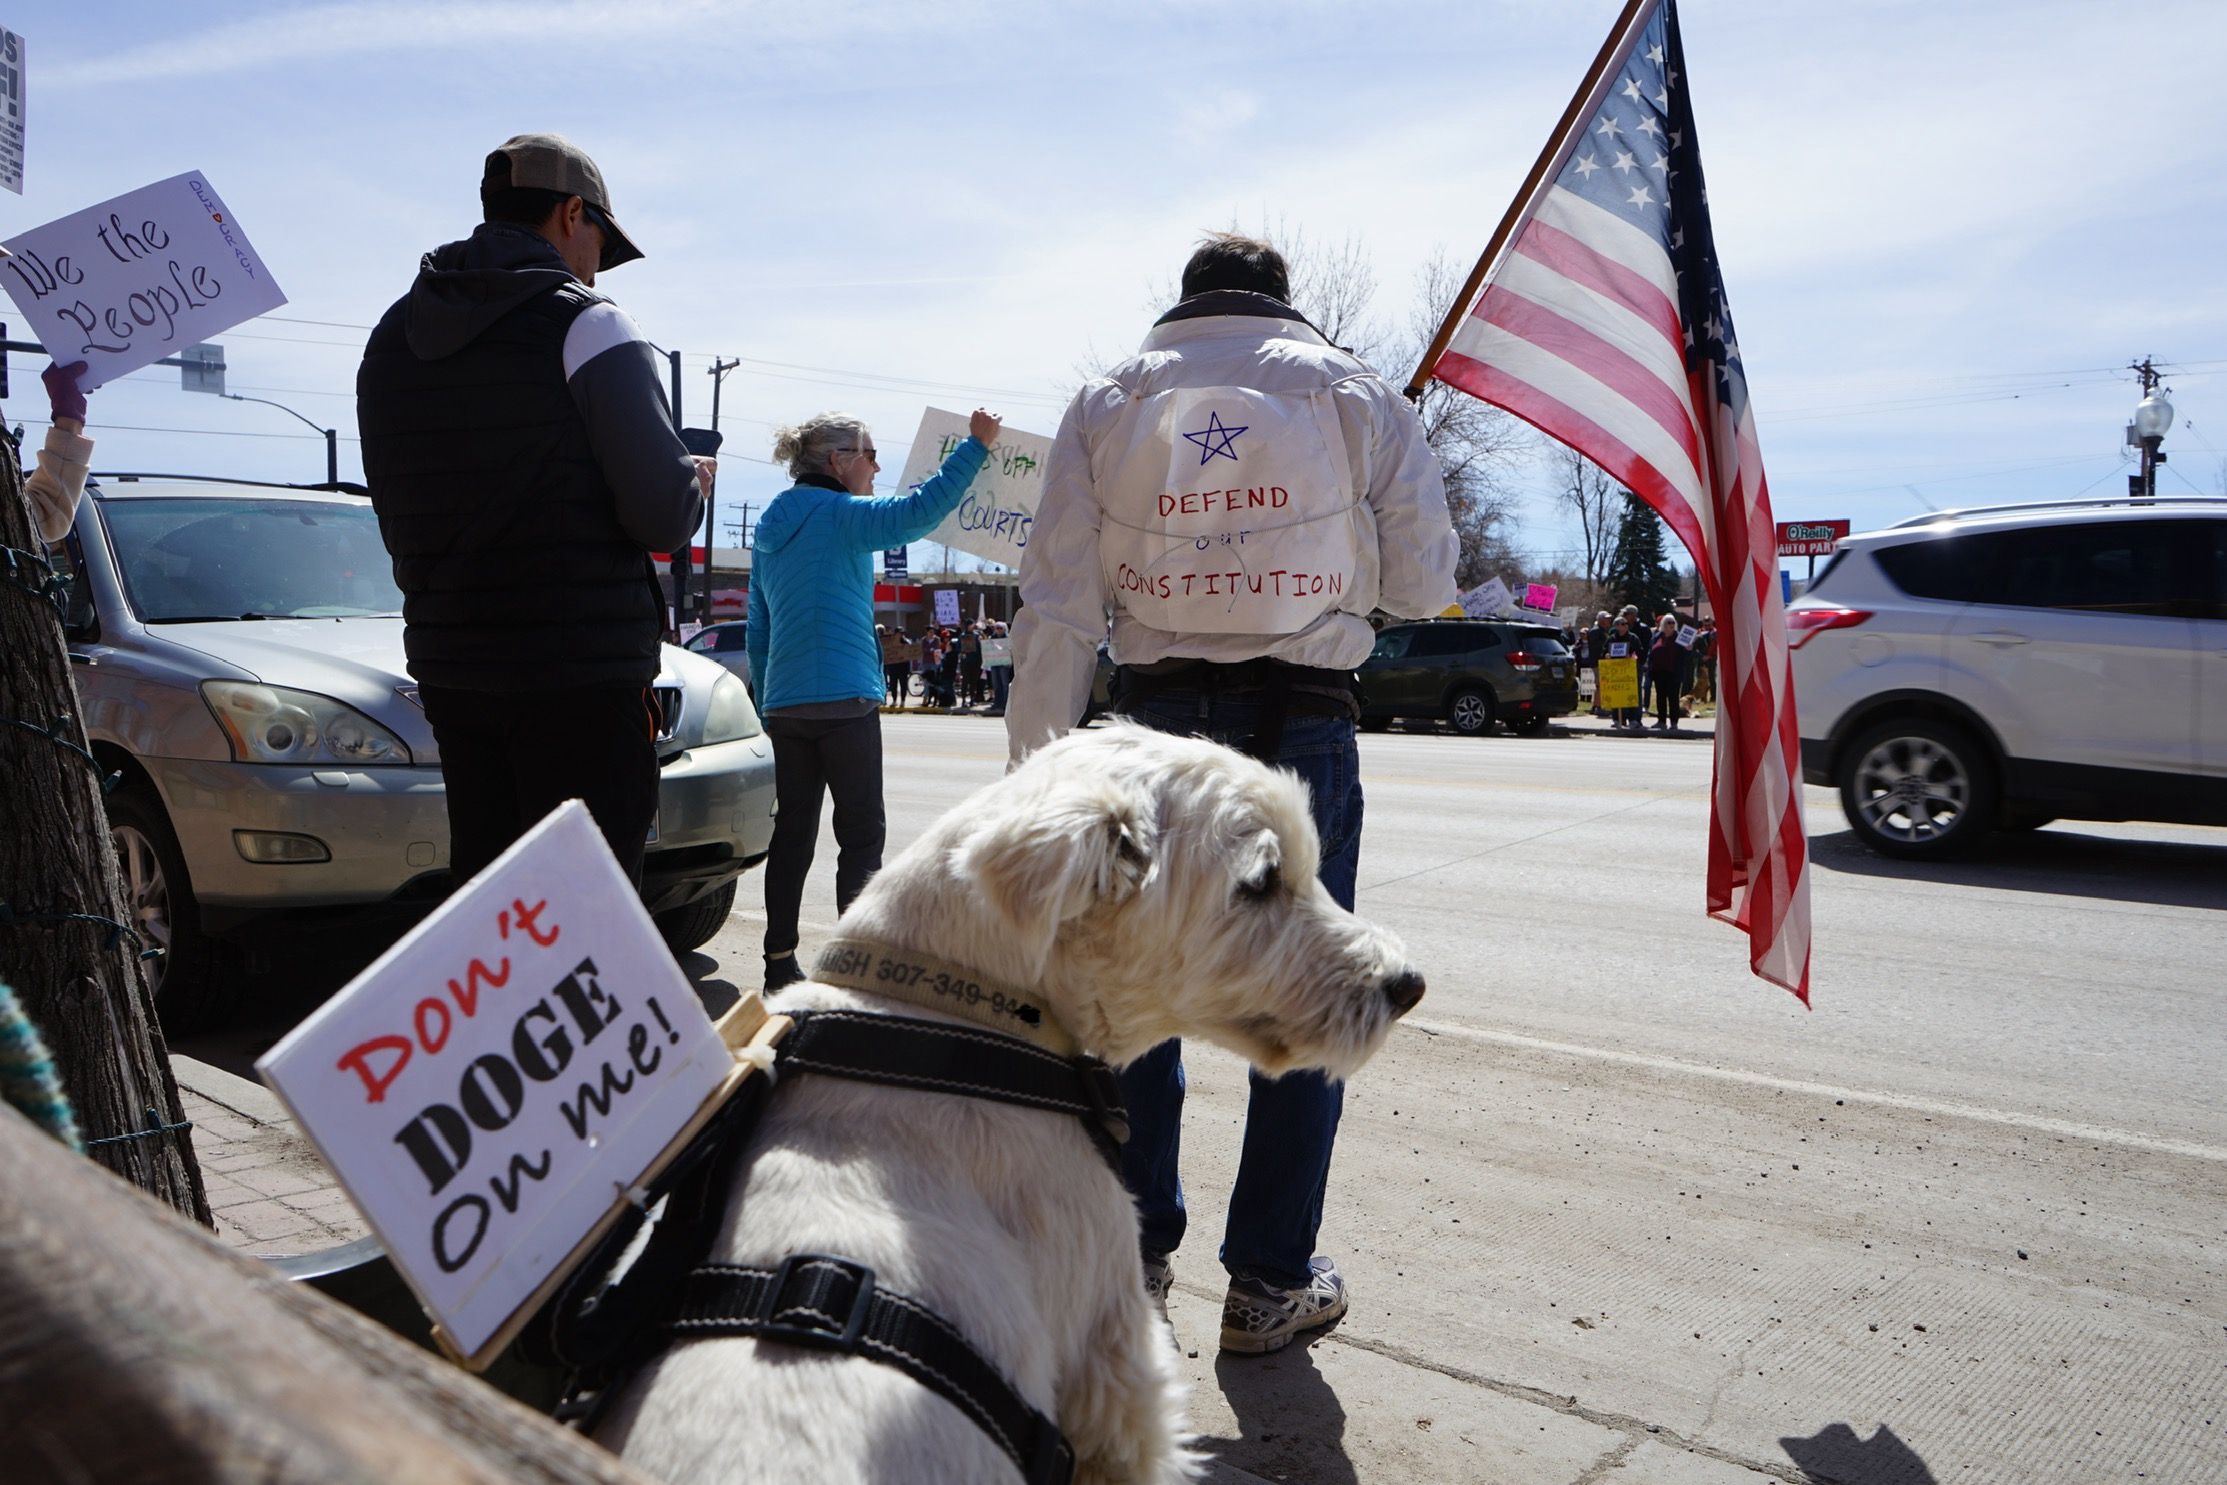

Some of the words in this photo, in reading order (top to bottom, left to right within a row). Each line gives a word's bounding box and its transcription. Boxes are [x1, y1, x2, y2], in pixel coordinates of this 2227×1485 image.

[7, 250, 85, 300] We
[97, 213, 170, 263] the
[57, 260, 221, 354] People
[1003, 457, 1036, 479] OFF
[958, 496, 1033, 547] COURTS
[1158, 487, 1288, 517] DEFEND
[1778, 543, 1806, 554] AUTO
[1810, 541, 1839, 554] PART
[1787, 524, 1835, 541] O'Reilly
[1117, 563, 1342, 599] CONSTITUTION
[336, 898, 561, 1104] Don't
[876, 958, 1043, 1028] 307-349-94
[394, 956, 623, 1196] DOGE
[559, 997, 681, 1141] me!
